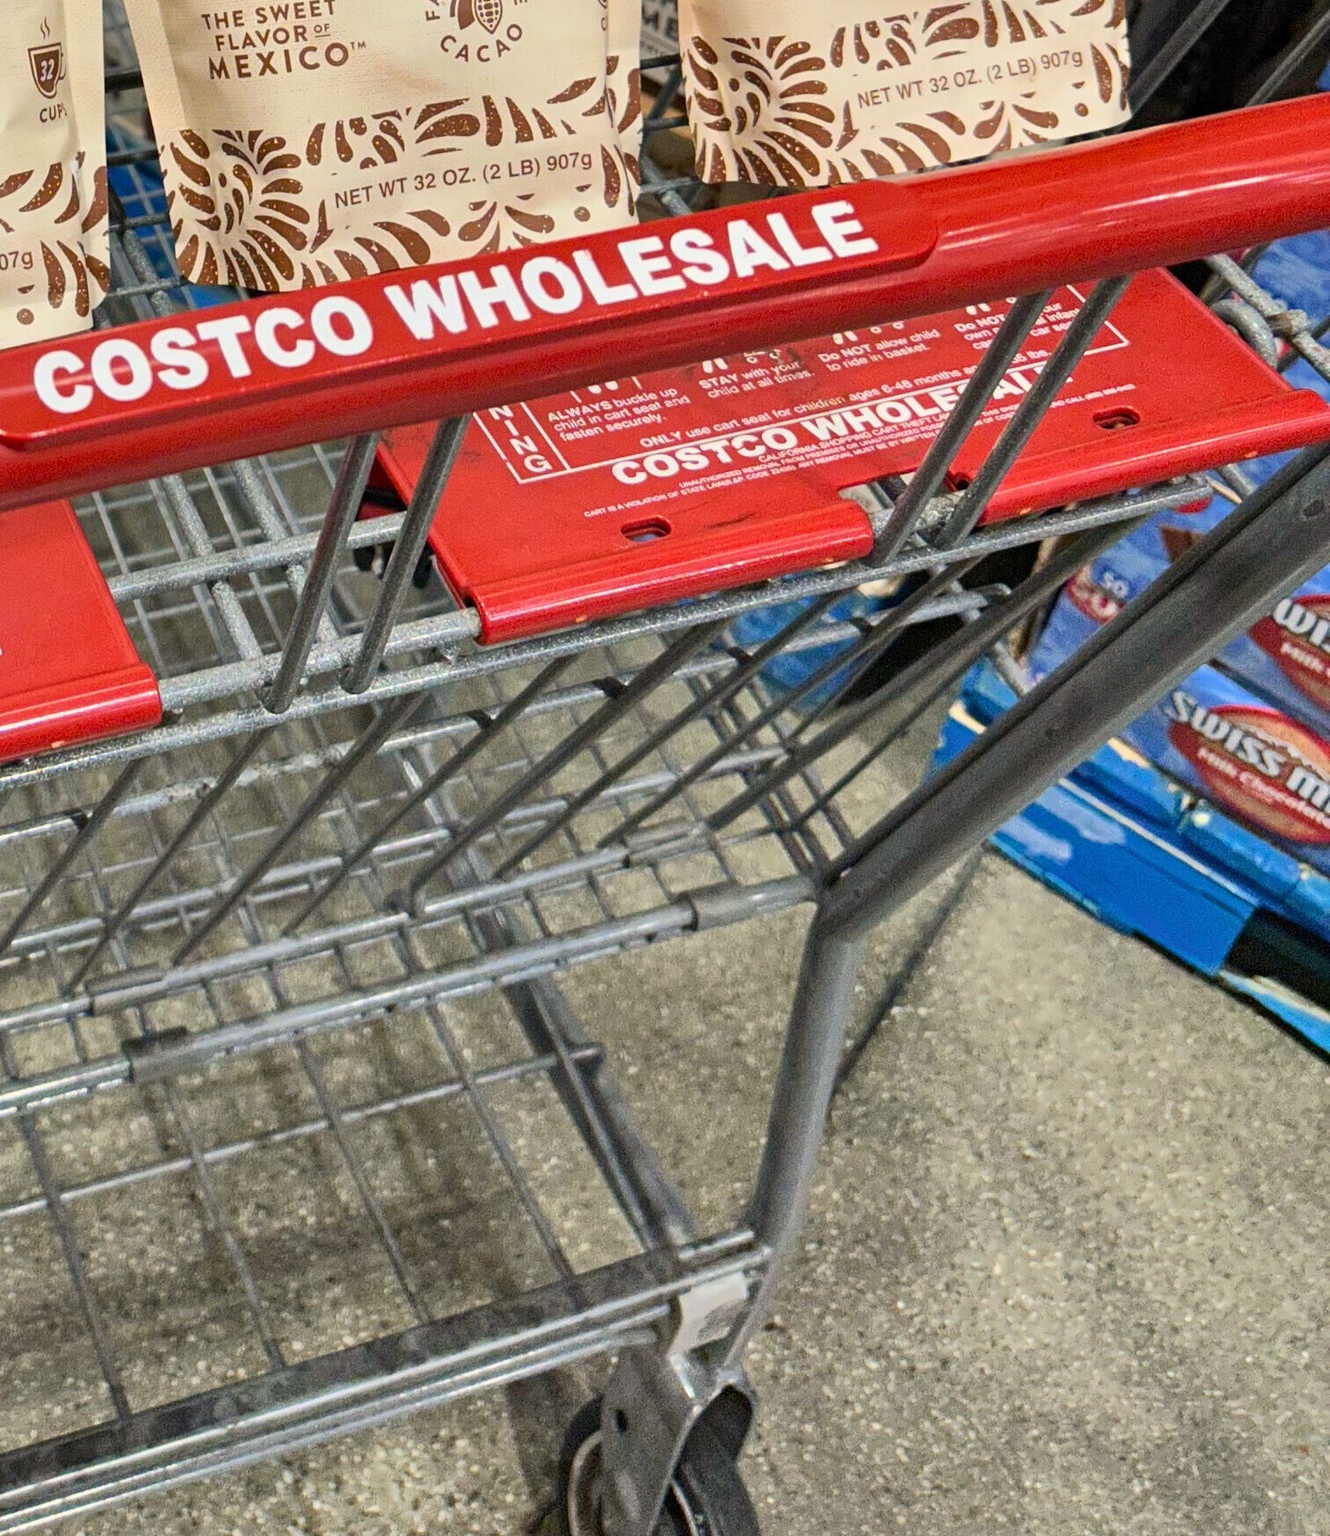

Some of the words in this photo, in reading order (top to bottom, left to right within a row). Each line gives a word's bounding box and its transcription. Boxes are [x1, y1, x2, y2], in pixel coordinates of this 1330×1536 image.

[202, 10, 245, 30] THE
[215, 26, 307, 51] FLAVOR
[313, 24, 330, 35] OF
[858, 89, 891, 109] NET
[896, 81, 925, 99] WT
[930, 76, 949, 93] 32
[954, 69, 983, 89] OZ.
[987, 64, 1003, 85] (2
[1007, 57, 1037, 79] LB)
[1041, 50, 1083, 71] 907g
[33, 296, 374, 413] COSTCO
[384, 200, 878, 342] WHOLESALE
[612, 427, 798, 485] COSTCO
